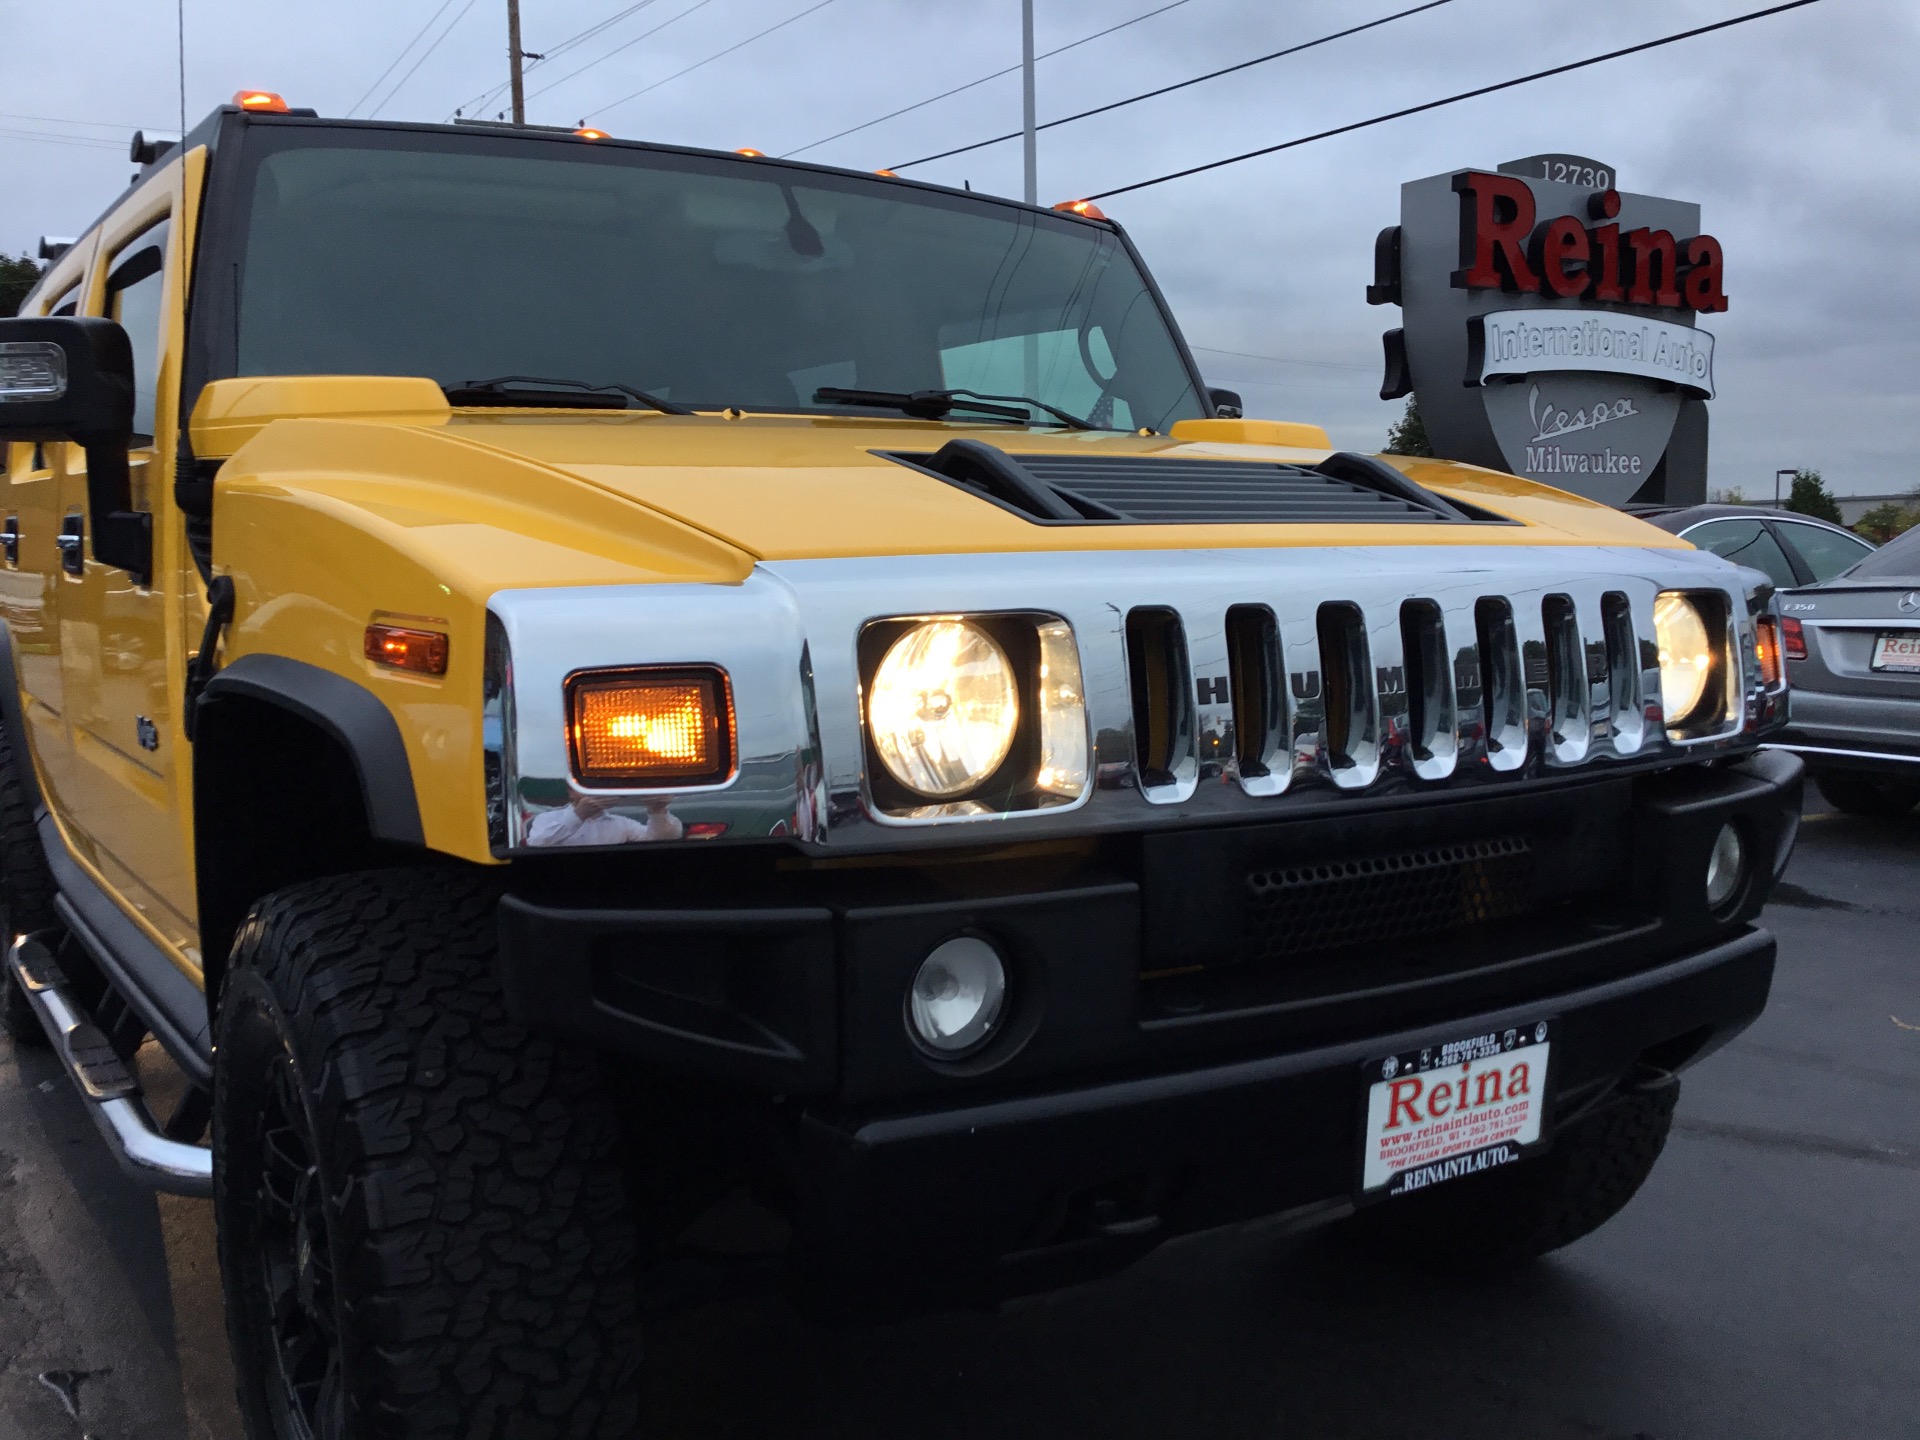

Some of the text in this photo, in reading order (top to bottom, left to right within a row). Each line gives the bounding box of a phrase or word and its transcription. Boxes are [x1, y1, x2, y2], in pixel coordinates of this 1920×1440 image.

[1542, 160, 1609, 189] 12730
[1462, 171, 1728, 313] Reina
[1491, 318, 1708, 379] International Auto
[1528, 383, 1639, 442] Vespa
[1525, 446, 1641, 475] Milwaukee
[1792, 603, 1816, 611] 350
[1883, 639, 1920, 654] Rei
[1441, 1033, 1496, 1056] BROOKFIELD
[1384, 1062, 1531, 1131] Reina
[1380, 1101, 1529, 1147] www.reinaintlauto.com
